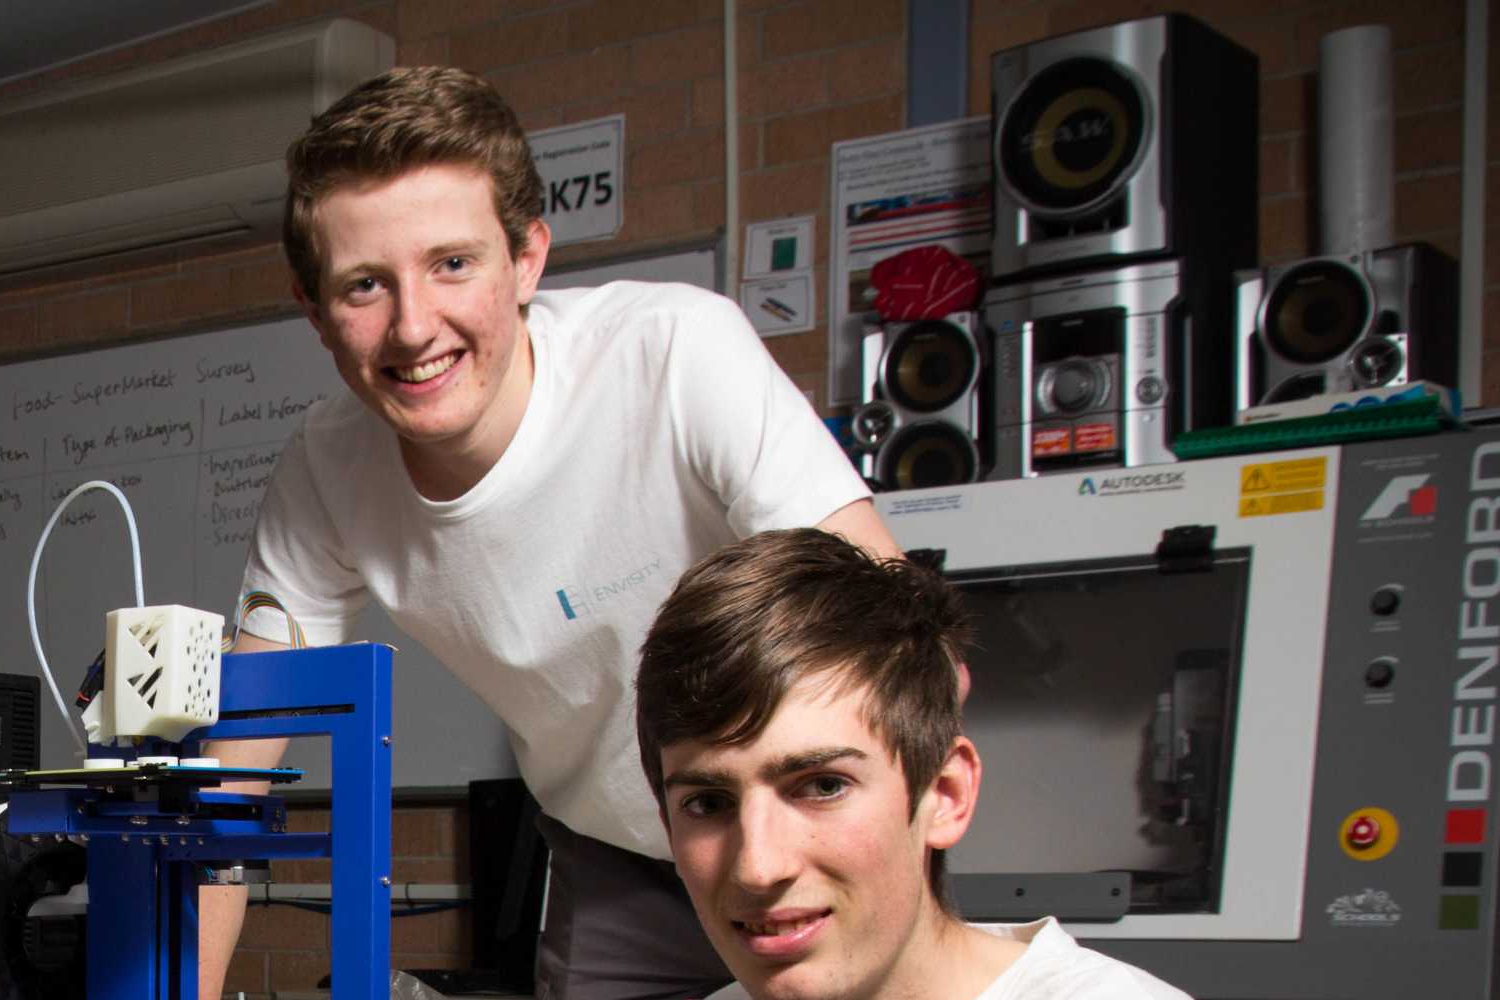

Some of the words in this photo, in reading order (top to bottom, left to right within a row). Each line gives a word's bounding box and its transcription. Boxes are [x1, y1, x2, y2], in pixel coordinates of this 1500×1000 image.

[195, 357, 256, 384] Survey
[218, 401, 261, 427] Label
[61, 433, 97, 465] Type
[124, 418, 195, 448] Packaging
[1100, 470, 1187, 490] AUTODESK
